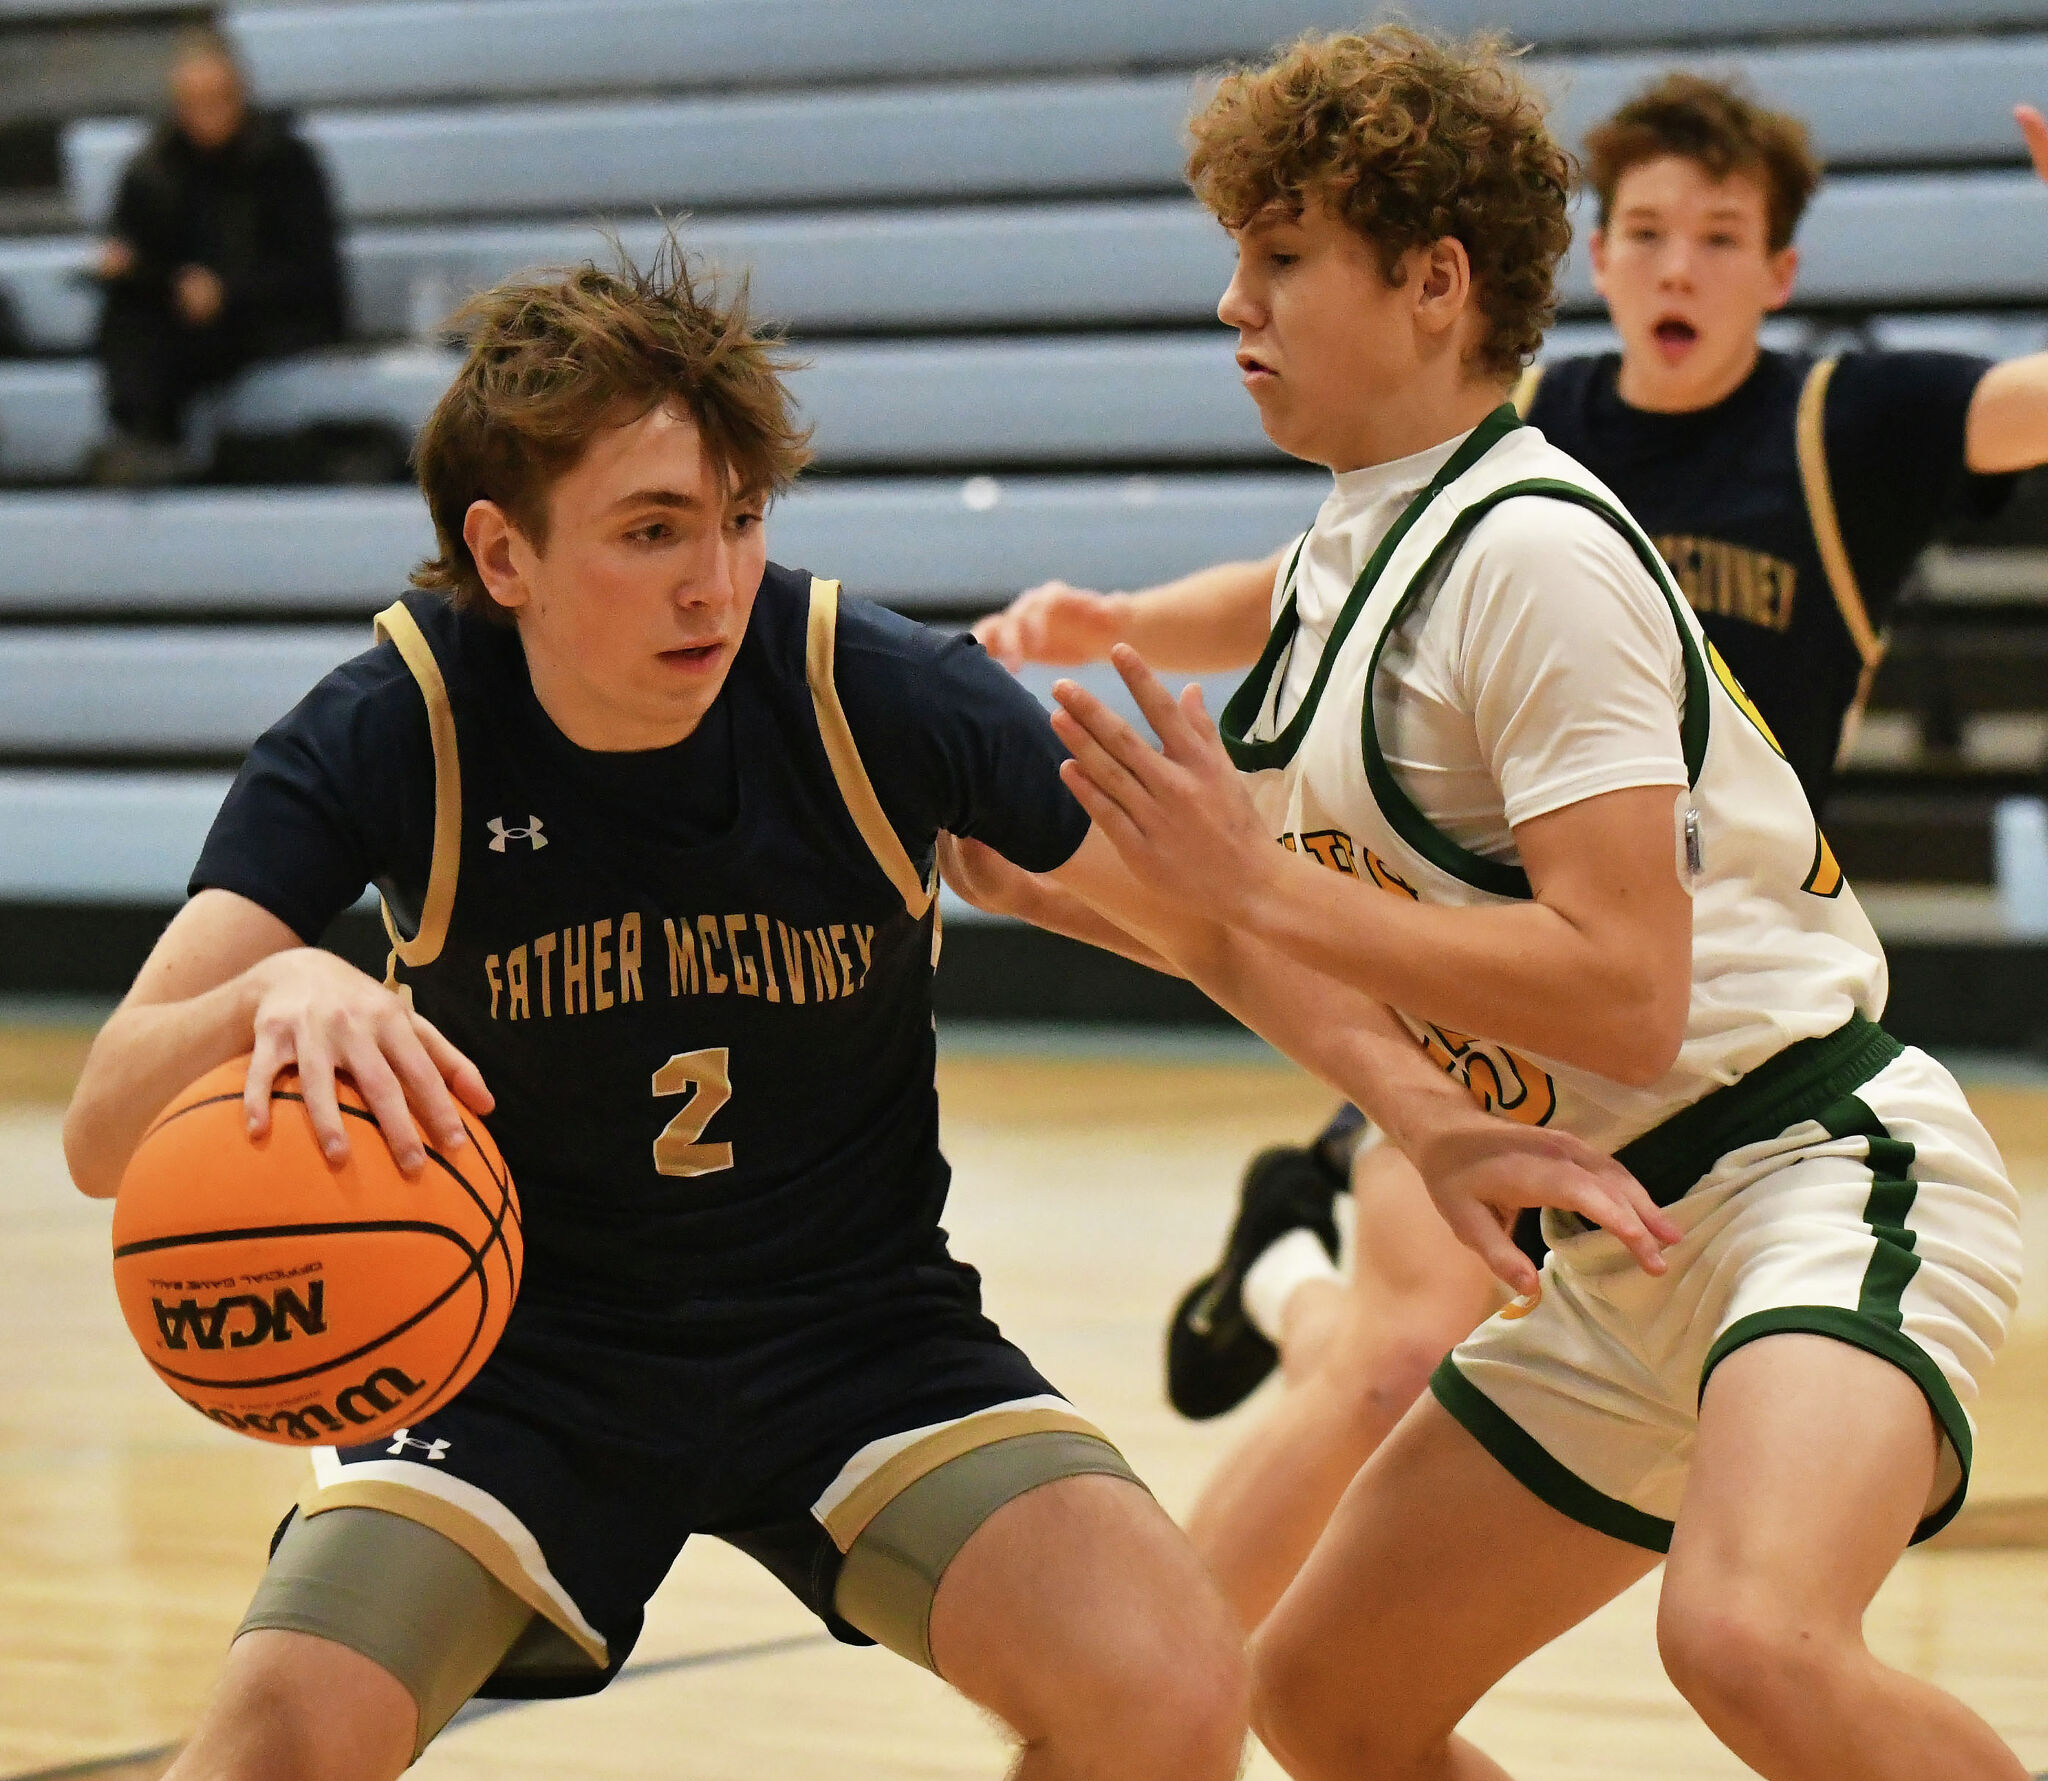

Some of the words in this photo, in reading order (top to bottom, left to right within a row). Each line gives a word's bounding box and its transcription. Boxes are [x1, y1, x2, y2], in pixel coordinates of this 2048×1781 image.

[485, 911, 644, 1020] FATHER
[663, 913, 875, 1004] MCGIVNEY
[652, 1046, 734, 1177] 2
[152, 1280, 328, 1350] NCAA
